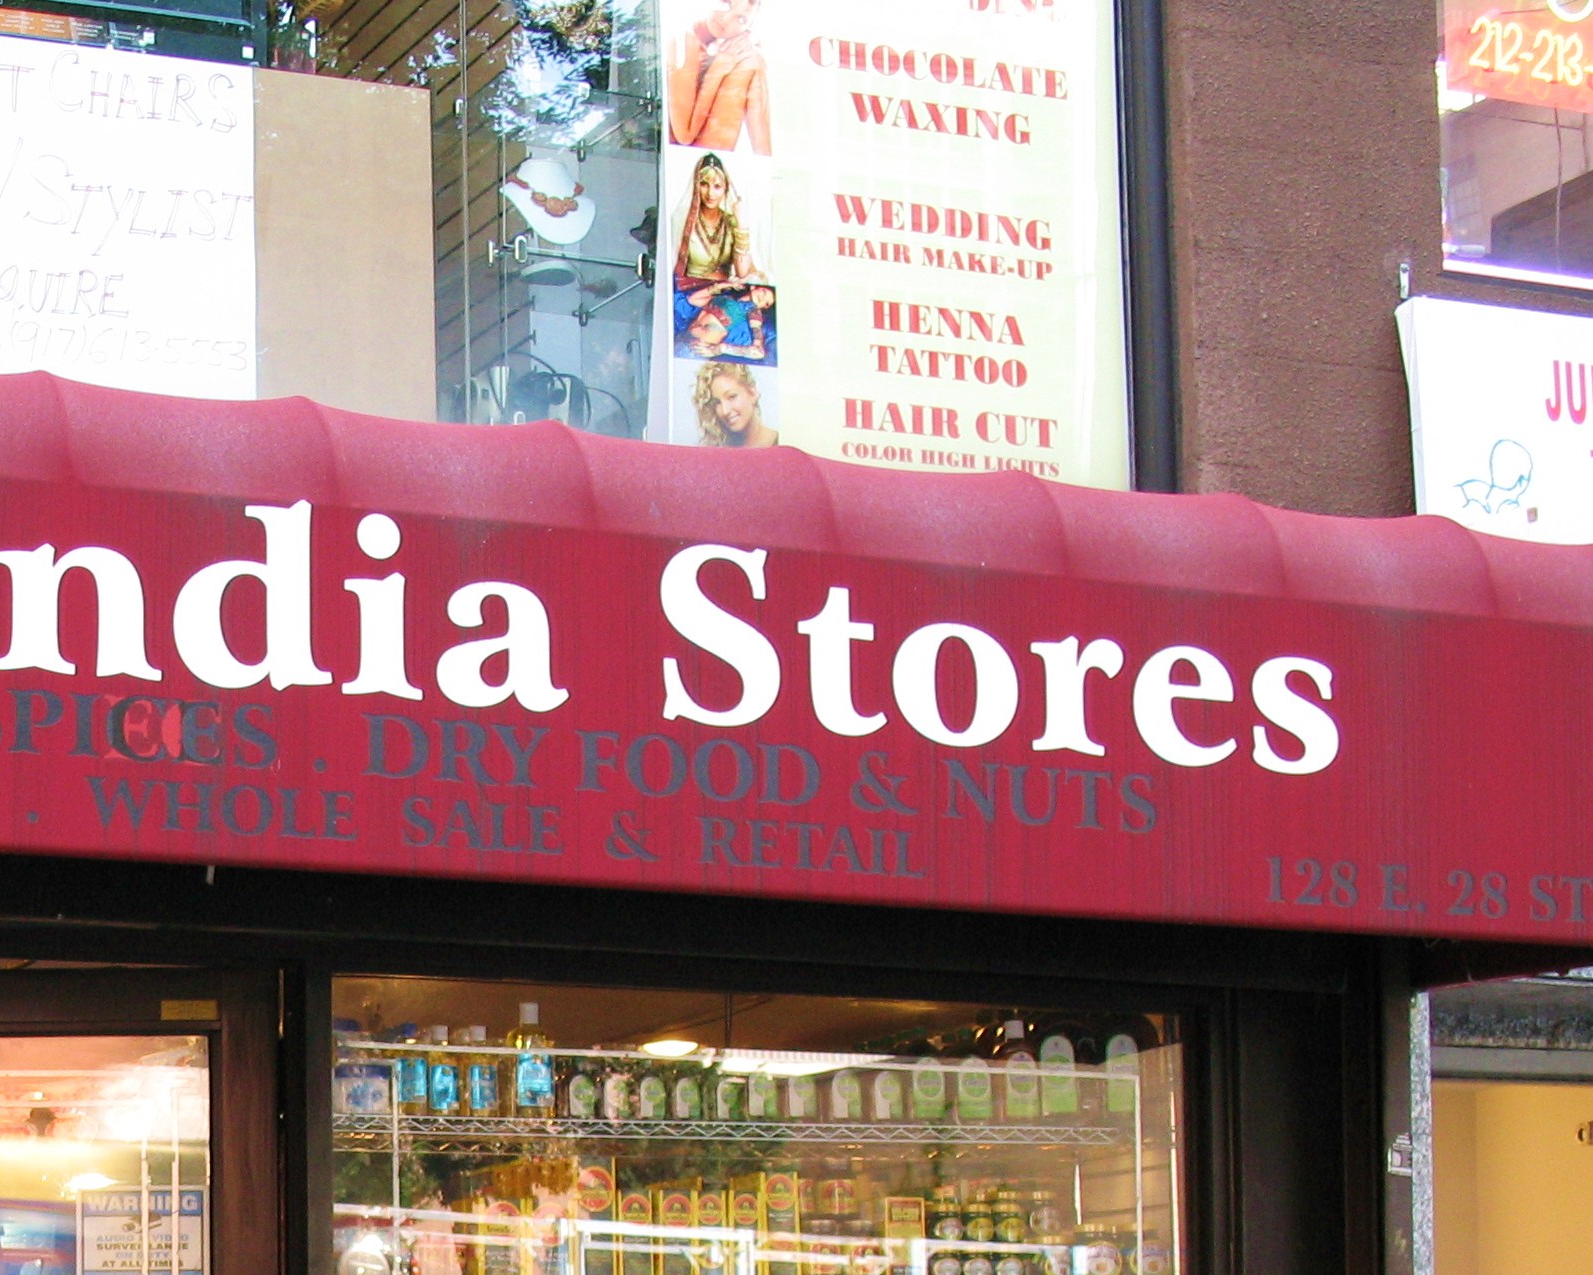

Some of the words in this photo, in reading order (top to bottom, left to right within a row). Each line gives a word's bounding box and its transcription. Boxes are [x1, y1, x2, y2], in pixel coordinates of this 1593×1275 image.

[49, 51, 239, 134] CHAIRS
[809, 36, 1068, 100] CHOCOLATE
[850, 91, 1032, 146] WAXING
[834, 193, 1052, 252] WEDDING
[837, 237, 911, 264] HAIR
[922, 249, 1053, 282] MAKE-UP
[870, 300, 1025, 347] HENNA
[870, 344, 1028, 388] TATTOO
[842, 397, 960, 439] HAIR
[975, 411, 1059, 449] CUT
[841, 442, 915, 464] COLOR
[920, 449, 976, 471] HIGH
[984, 454, 1060, 478] LIGHTS
[660, 544, 1341, 775] Stores
[362, 713, 550, 791] DRY
[576, 730, 821, 805] FOOD
[943, 758, 1158, 834] NUTS
[87, 775, 358, 841] WHOLE
[401, 798, 565, 855] SALE
[698, 815, 926, 879] RETAIL
[1266, 855, 1359, 909] 128
[1380, 863, 1429, 914] E.
[1447, 869, 1509, 919] 28
